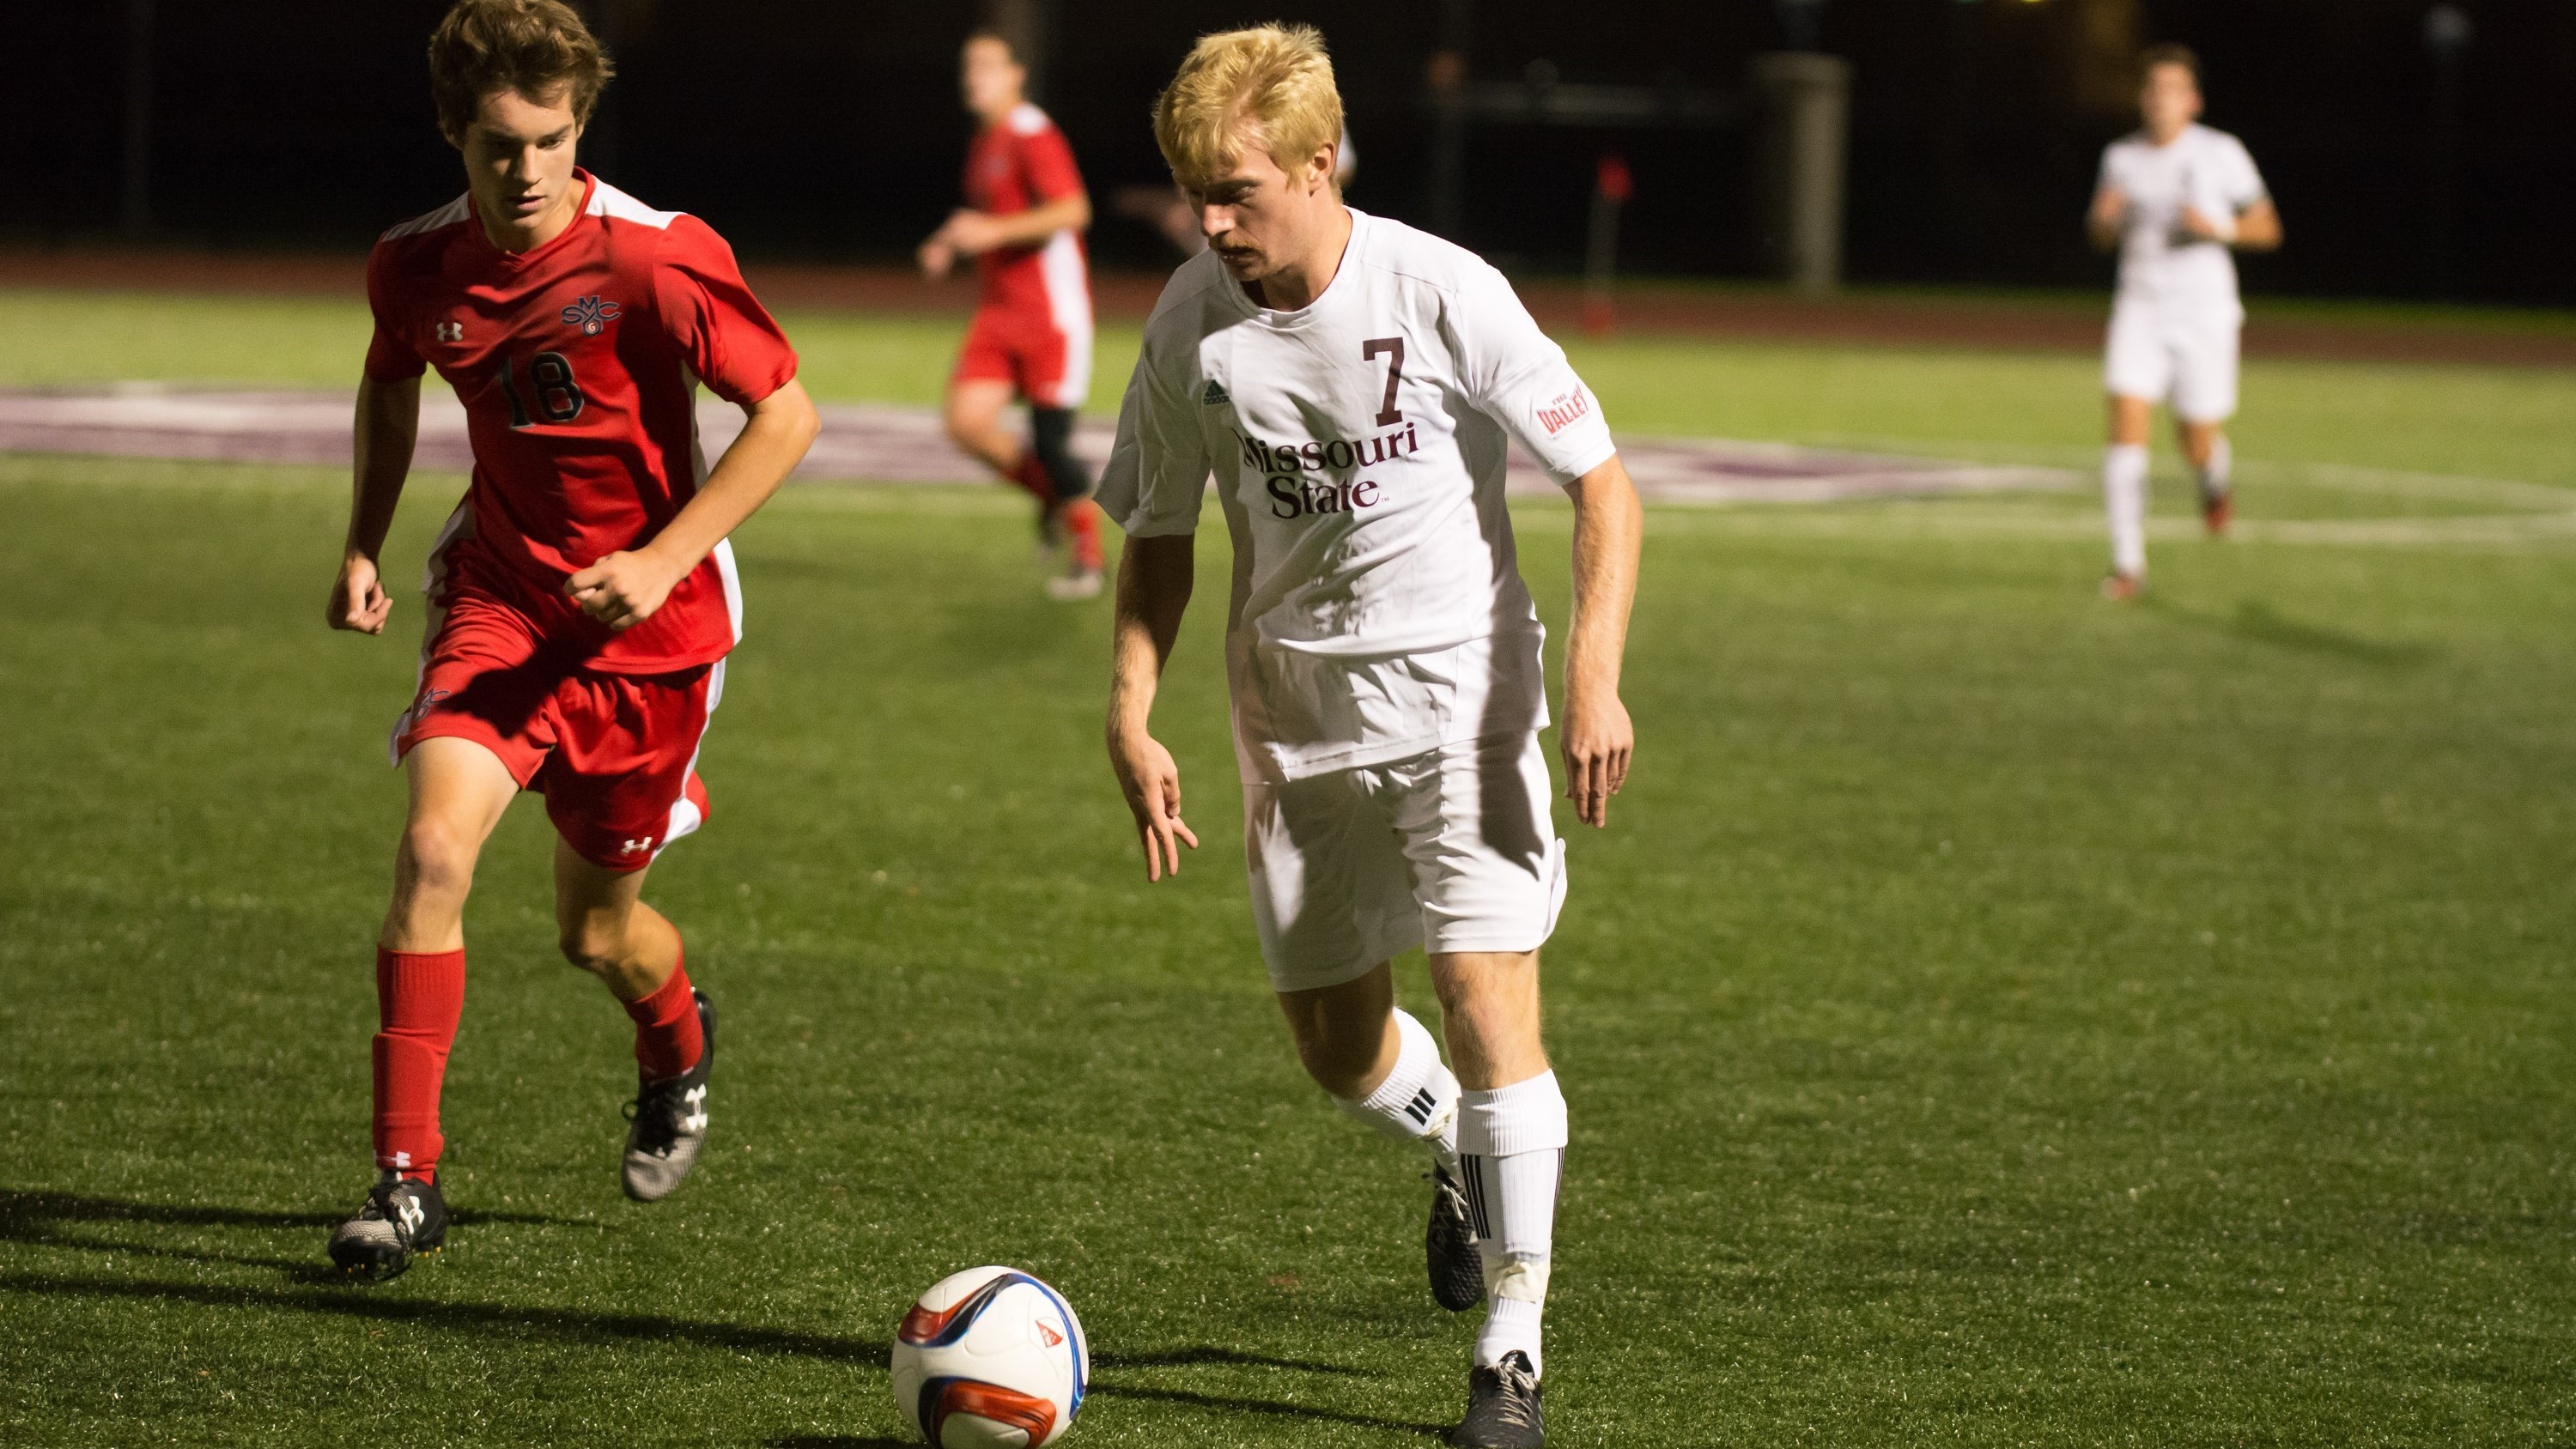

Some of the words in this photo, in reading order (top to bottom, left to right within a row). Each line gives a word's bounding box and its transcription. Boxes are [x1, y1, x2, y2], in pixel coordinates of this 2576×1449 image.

[495, 351, 585, 429] 18
[1363, 337, 1405, 427] 7
[1536, 383, 1589, 434] VALLEY
[1232, 421, 1419, 476] Missouri
[1267, 476, 1380, 519] State
